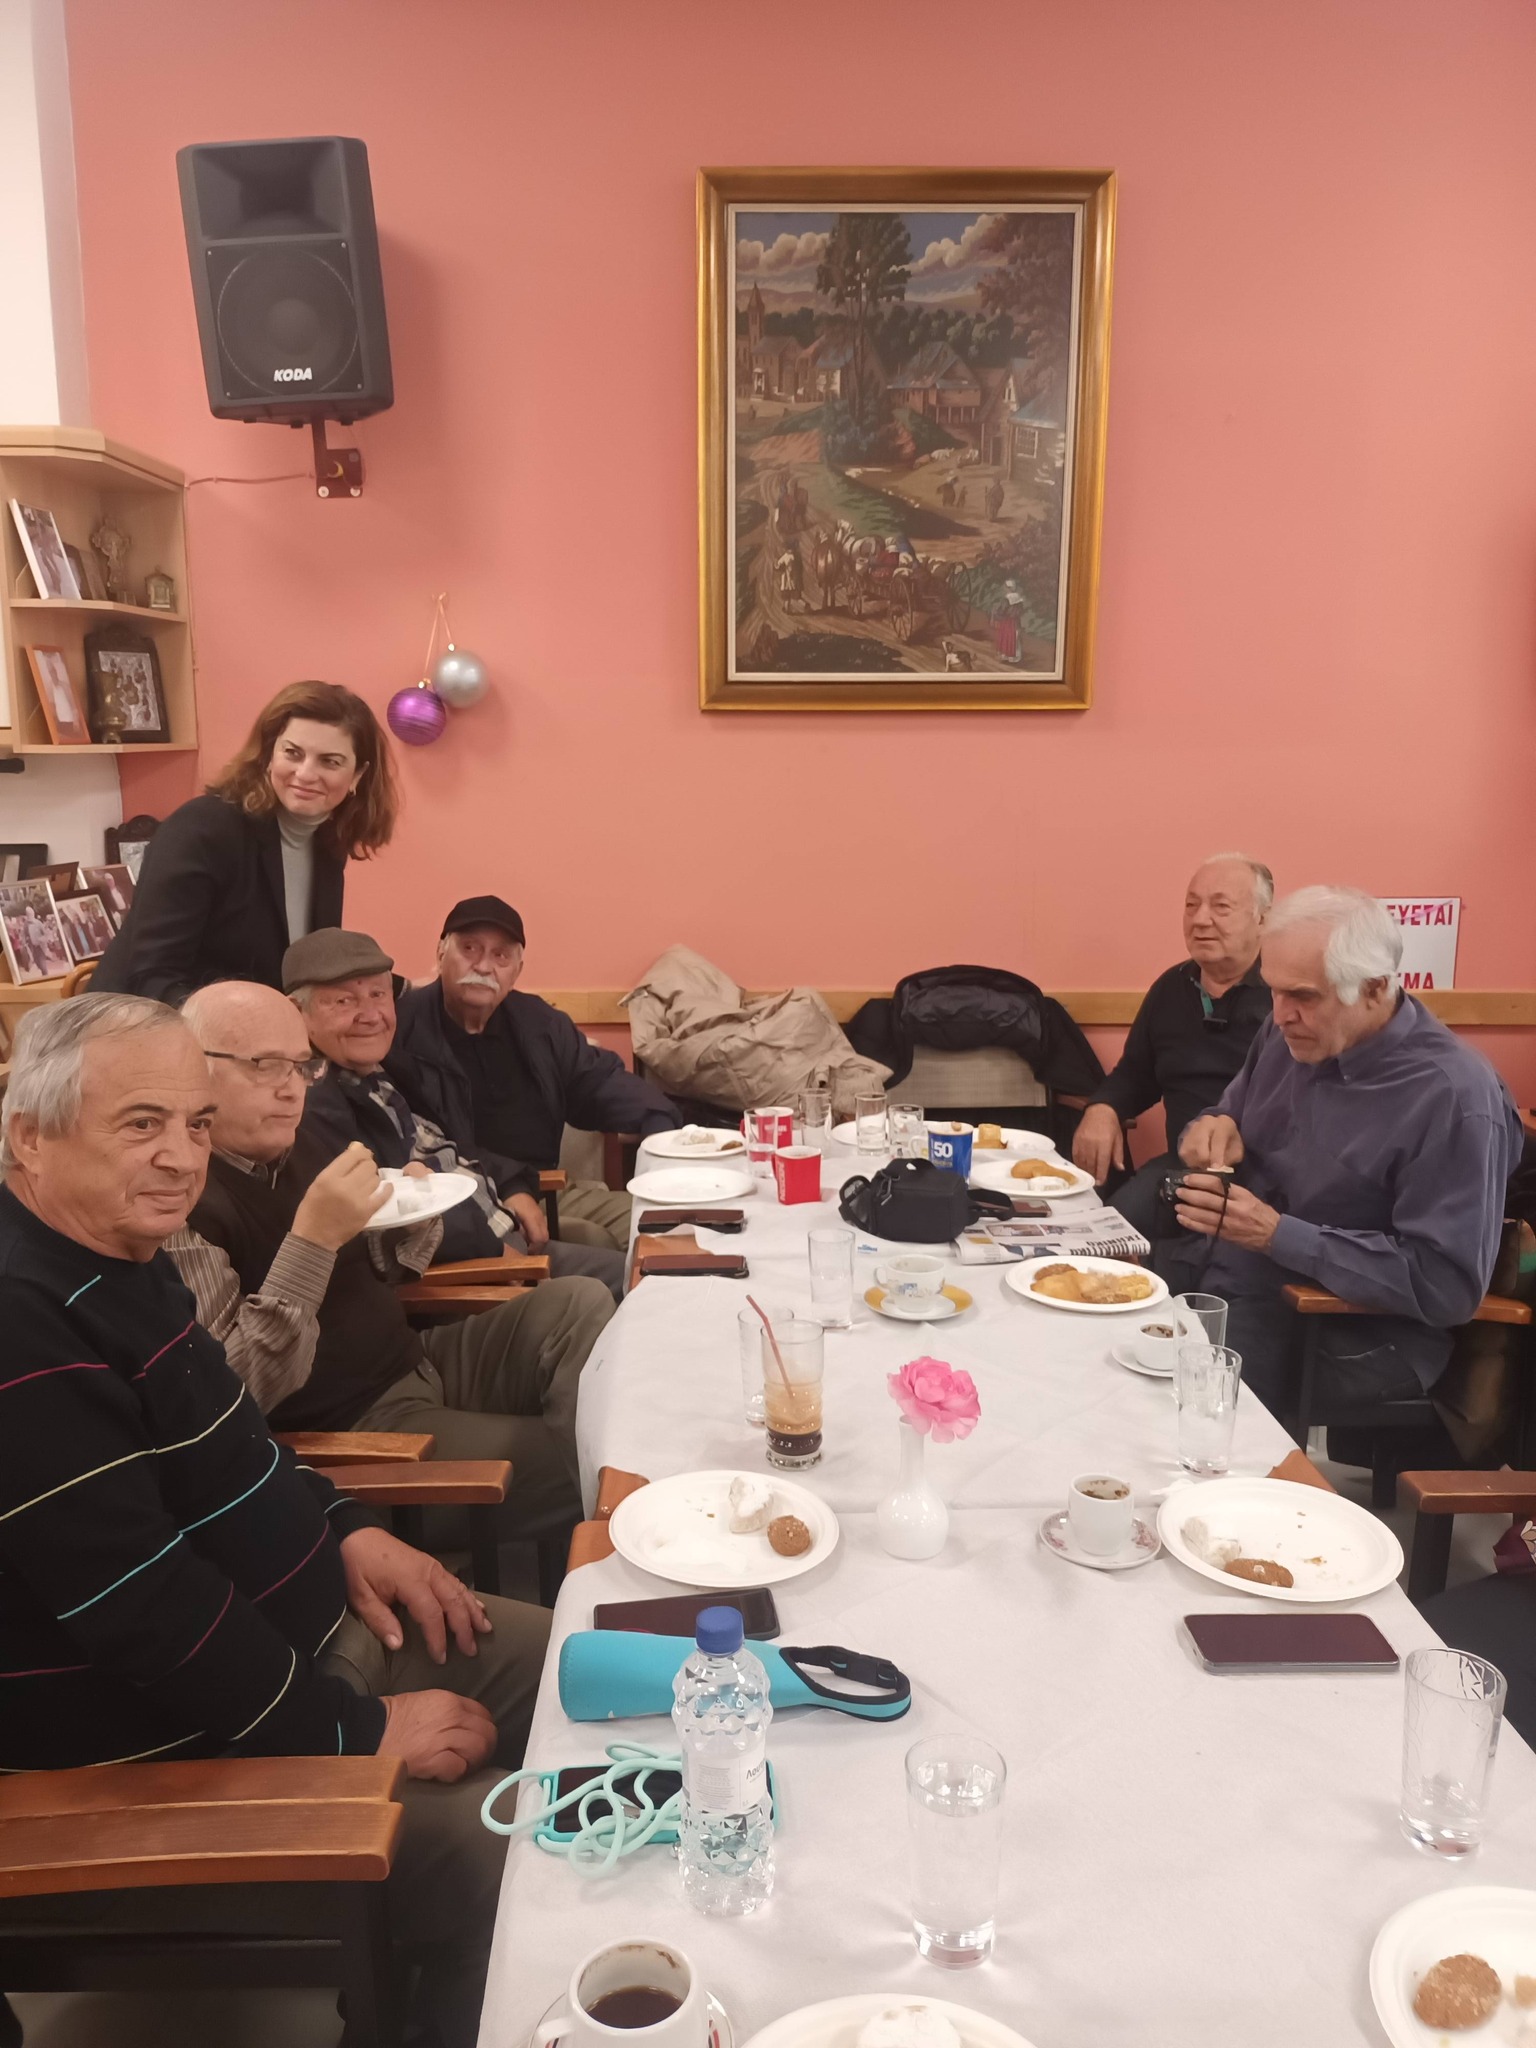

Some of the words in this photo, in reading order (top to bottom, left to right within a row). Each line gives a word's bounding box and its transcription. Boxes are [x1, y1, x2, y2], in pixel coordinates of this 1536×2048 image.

[273, 367, 313, 382] KODA
[1398, 972, 1434, 990] ΜΑ
[934, 1141, 954, 1159] 50
